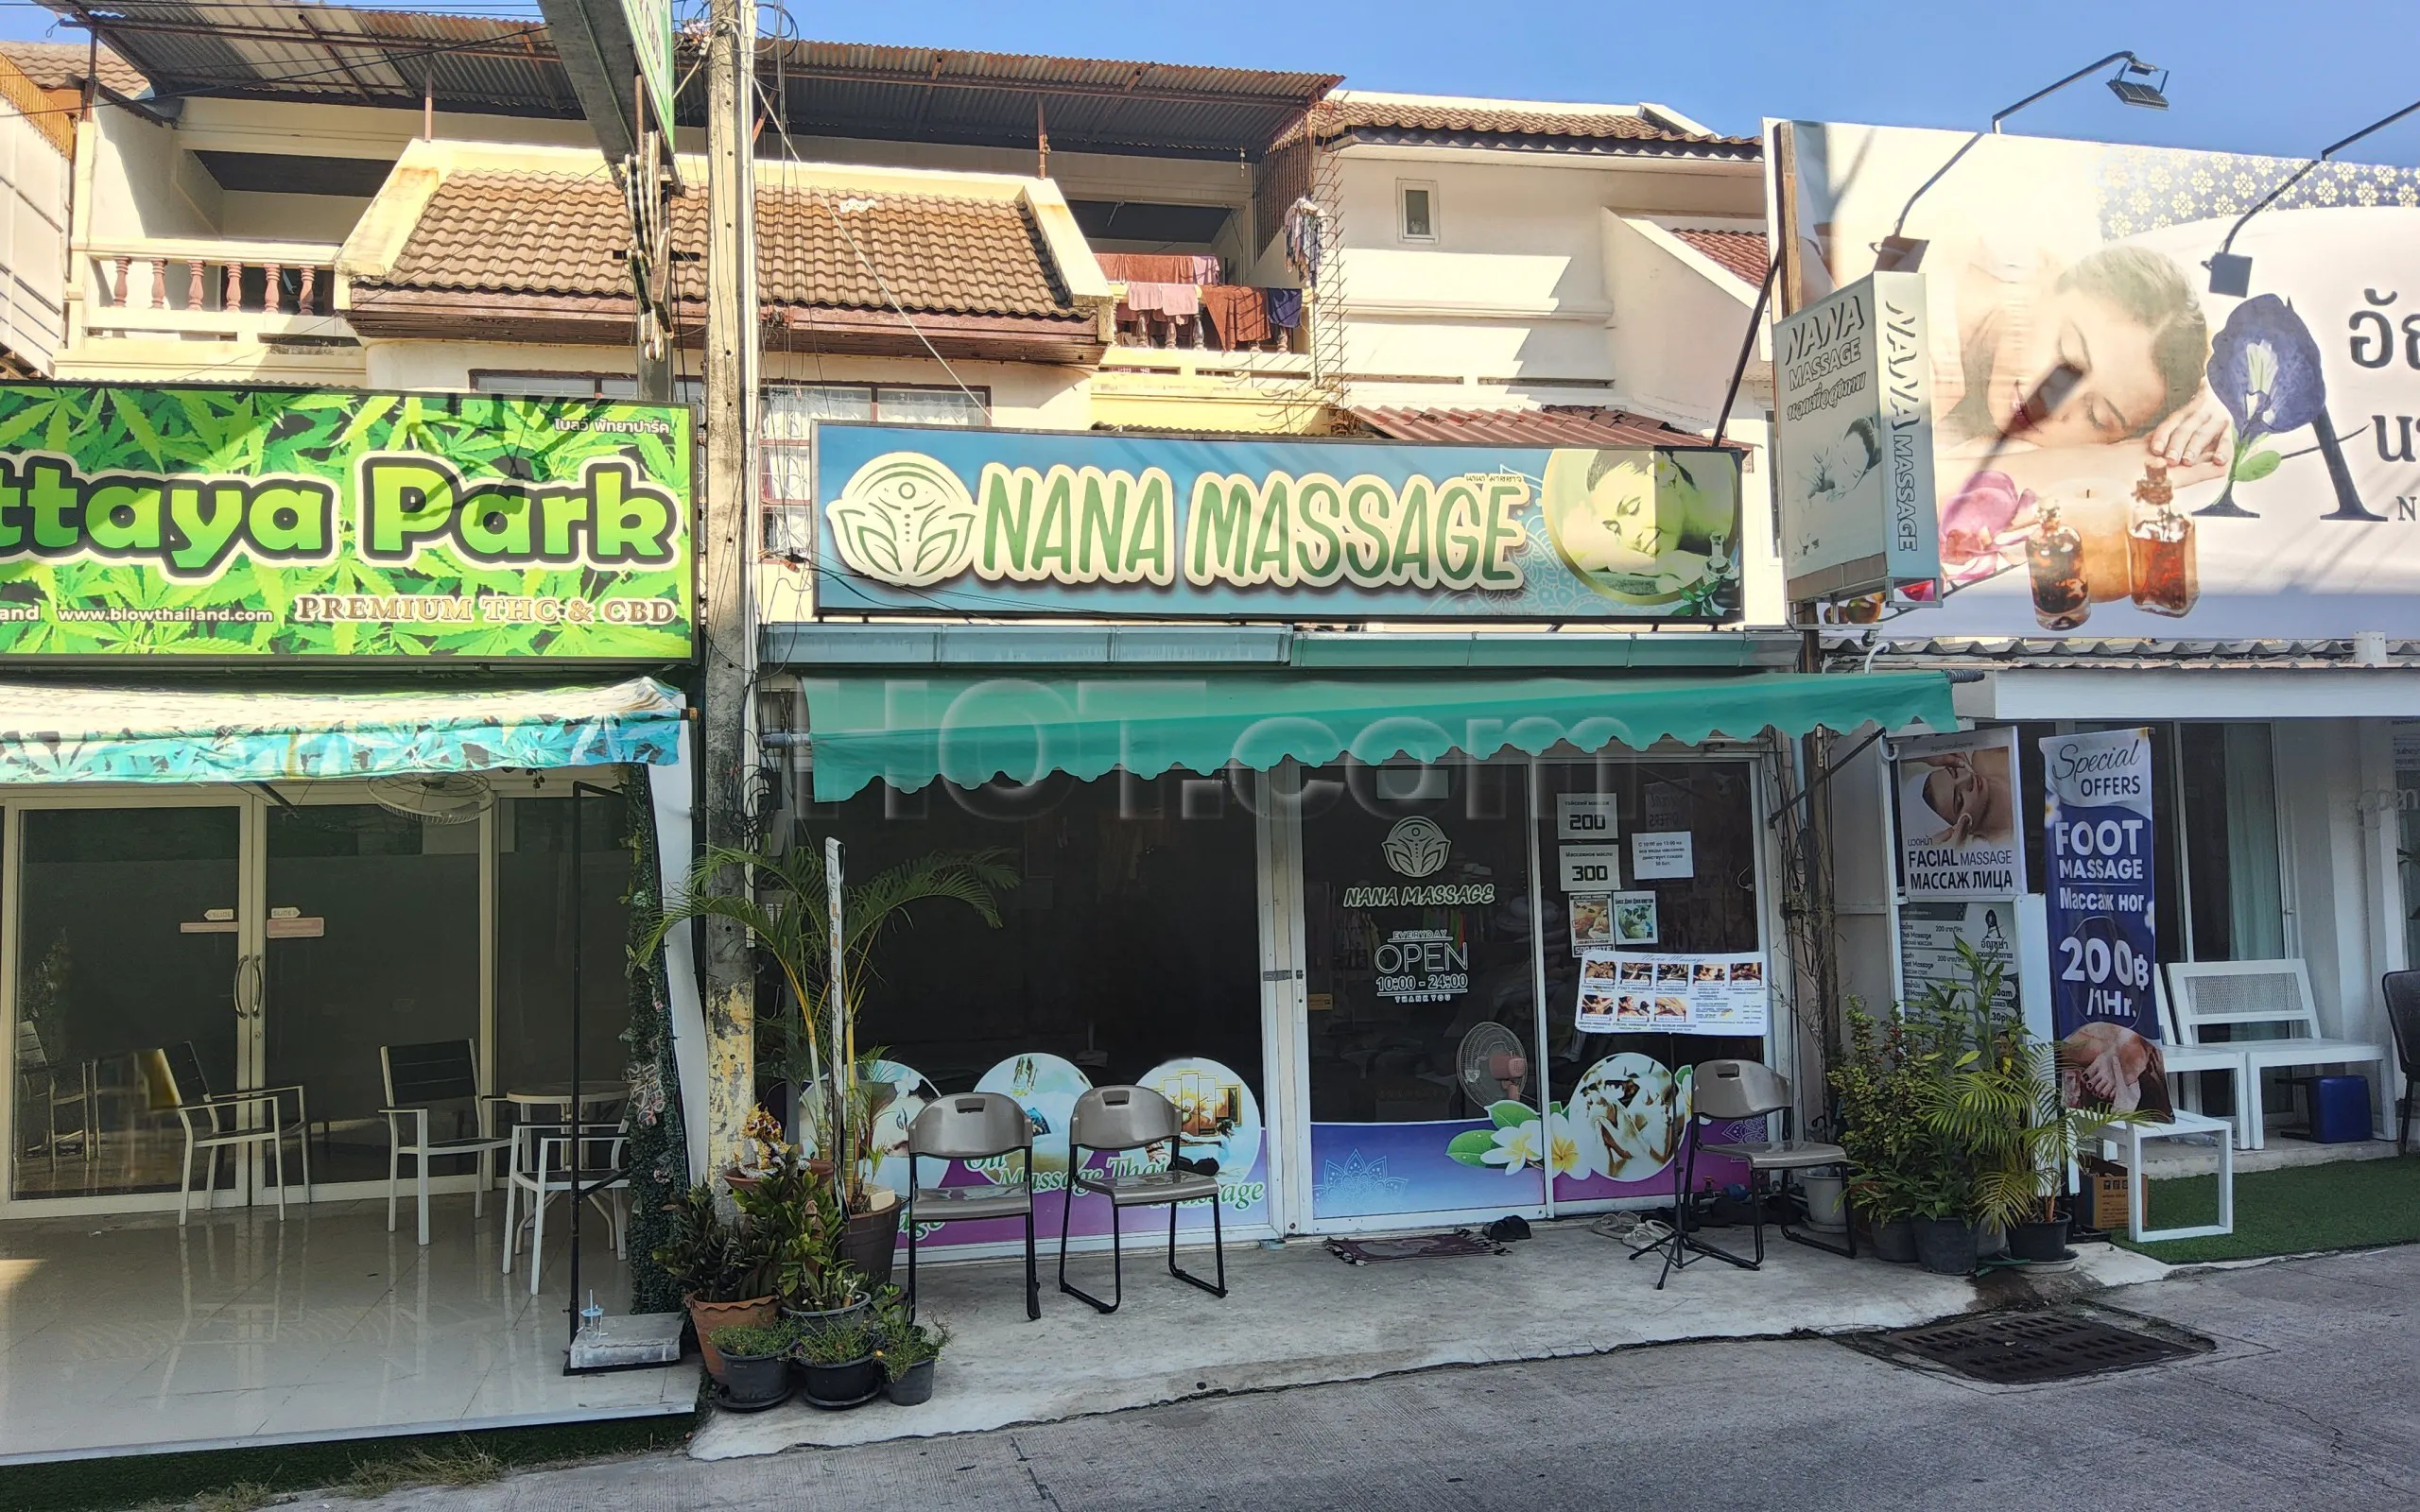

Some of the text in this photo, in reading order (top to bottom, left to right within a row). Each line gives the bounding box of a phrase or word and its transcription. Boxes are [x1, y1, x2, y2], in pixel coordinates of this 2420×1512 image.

[1785, 295, 1865, 366] NANA
[1789, 336, 1861, 391] MASSAGE
[594, 418, 670, 434] พัทยาปาร์ค
[1885, 301, 1921, 552] NANA MASSAGE
[2372, 415, 2420, 462] น
[370, 461, 667, 559] Park
[980, 466, 1524, 583] NANA MASSAGE
[58, 607, 273, 623] www.blowthailand.com
[296, 594, 676, 625] PREMIUM THC & CBD
[2052, 738, 2141, 782] Special
[2081, 775, 2141, 797] OFFERS
[1569, 815, 1606, 831] 200
[1908, 834, 1933, 847] นวดหน้า
[2054, 819, 2143, 856] FOOT
[1909, 849, 2013, 868] FACIAL MASSAGE
[2059, 858, 2144, 880] MASSAGE
[1572, 865, 1608, 882] 300
[1910, 869, 2013, 892] МАССАЖ ЛИЦА
[1343, 884, 1495, 907] NANA MASSAGE
[2059, 886, 2145, 912] Массаж ног
[1392, 929, 1448, 939] EVERYDAY
[1374, 941, 1468, 973] OPEN
[1376, 976, 1416, 991] 10:00
[1427, 973, 1468, 989] 24:00
[1394, 995, 1428, 1004] THANK
[2086, 988, 2137, 1018] /1Hr.
